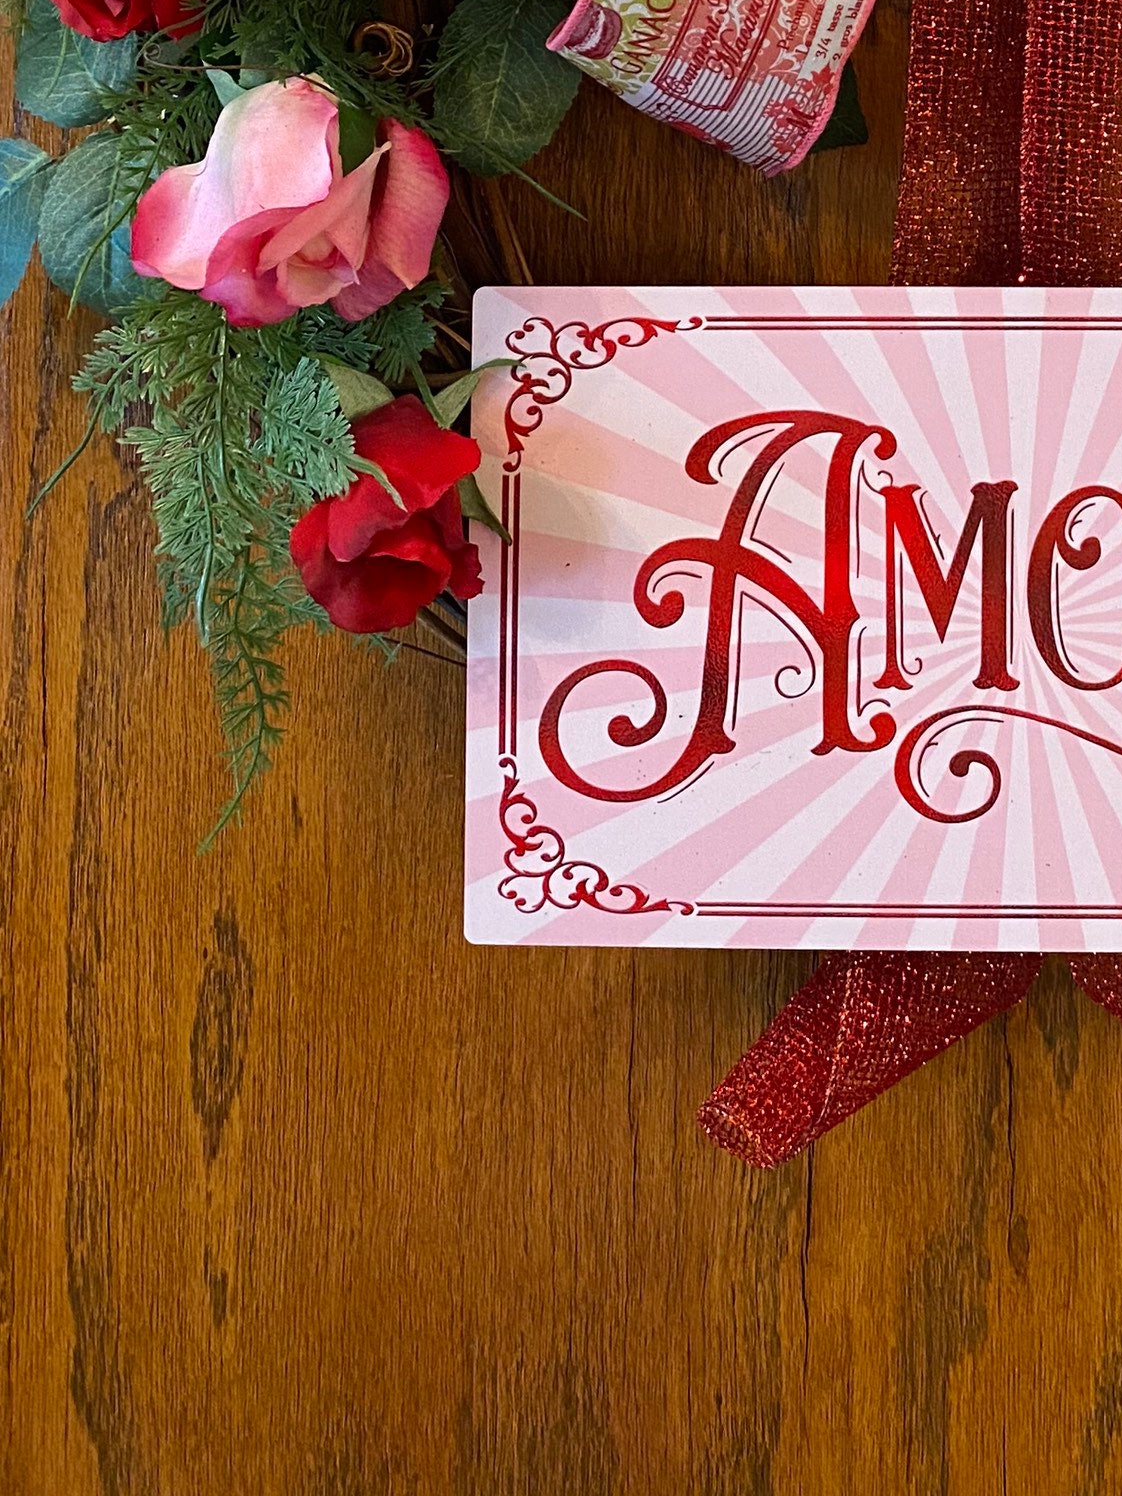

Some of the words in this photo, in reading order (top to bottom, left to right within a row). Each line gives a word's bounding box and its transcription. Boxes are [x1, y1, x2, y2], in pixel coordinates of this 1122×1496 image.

[662, 16, 720, 91] Comment
[815, 35, 830, 58] 3/4
[826, 4, 843, 32] tasse
[832, 53, 841, 61] 2
[838, 23, 852, 47] gros
